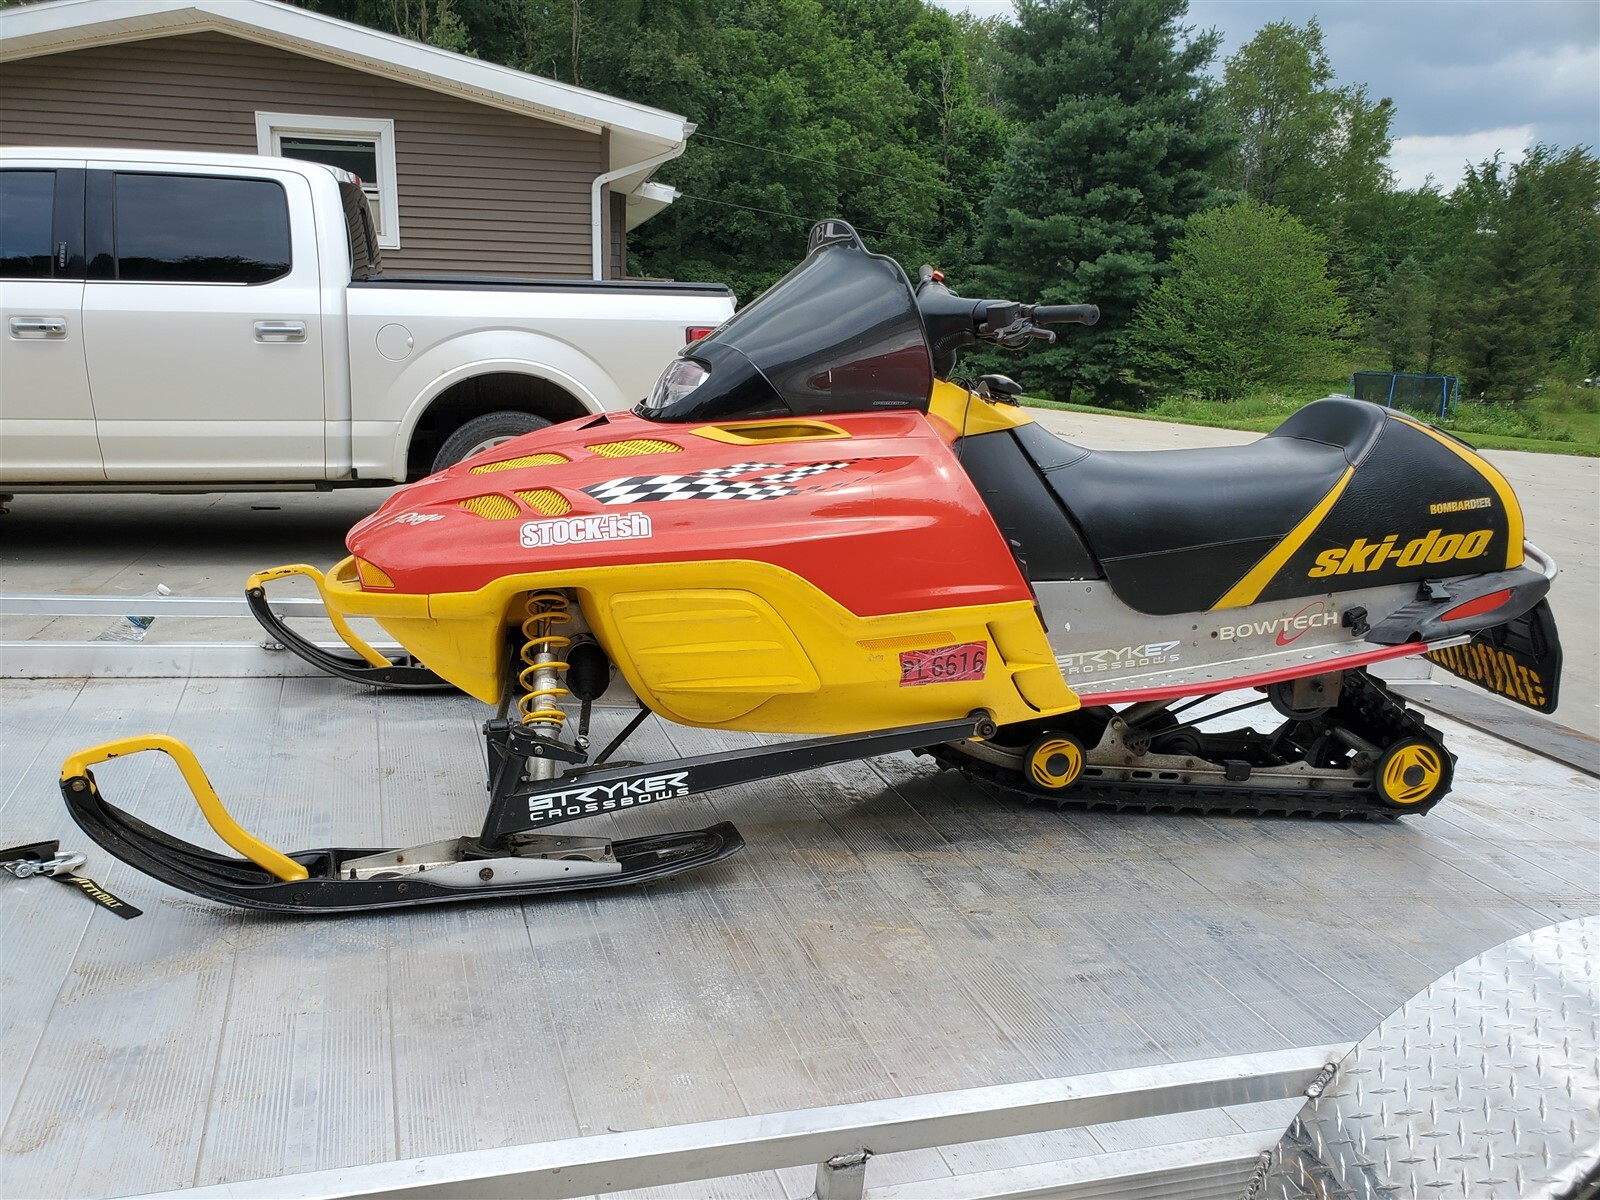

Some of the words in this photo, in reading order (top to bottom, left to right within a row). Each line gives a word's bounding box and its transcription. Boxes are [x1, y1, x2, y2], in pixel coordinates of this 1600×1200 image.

[1429, 497, 1492, 515] BOMBARDIER
[1307, 528, 1494, 578] ski-doo
[1219, 611, 1338, 641] BOWTECH
[529, 771, 689, 811] STRYKER
[530, 787, 689, 821] CROSSBOWS
